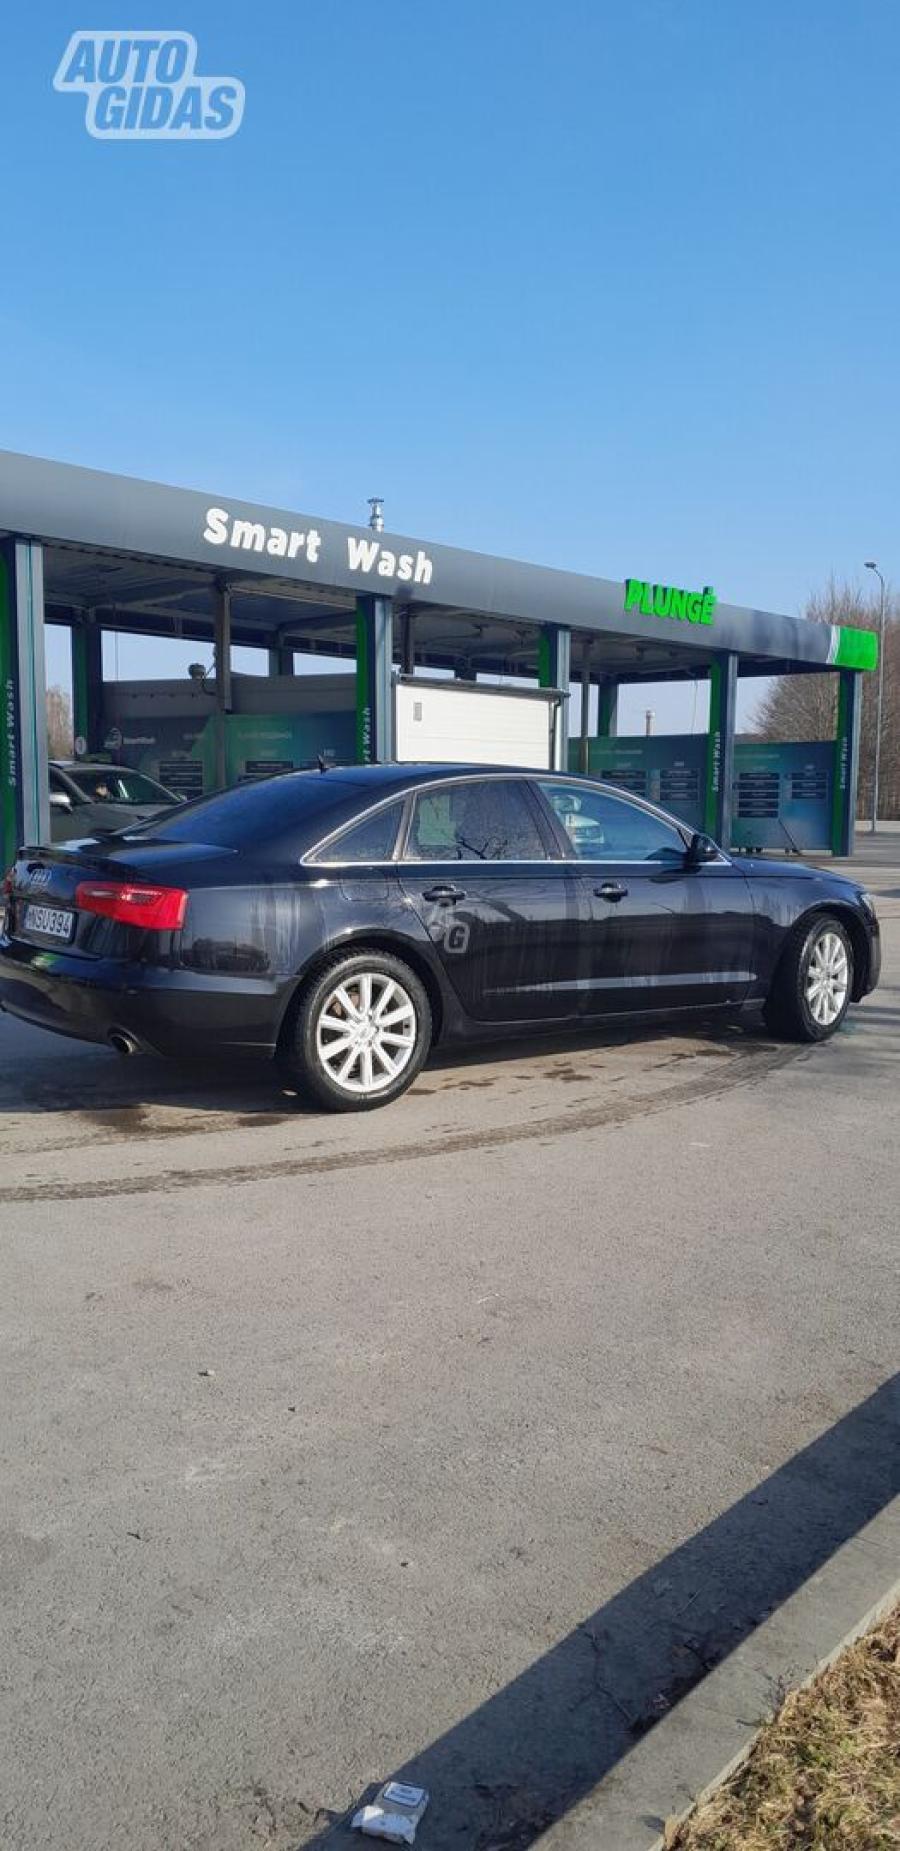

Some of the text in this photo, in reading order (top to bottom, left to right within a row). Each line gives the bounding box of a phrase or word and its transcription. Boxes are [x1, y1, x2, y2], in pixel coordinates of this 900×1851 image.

[203, 508, 433, 585] Smart Wash
[5, 679, 17, 787] Smart Wash
